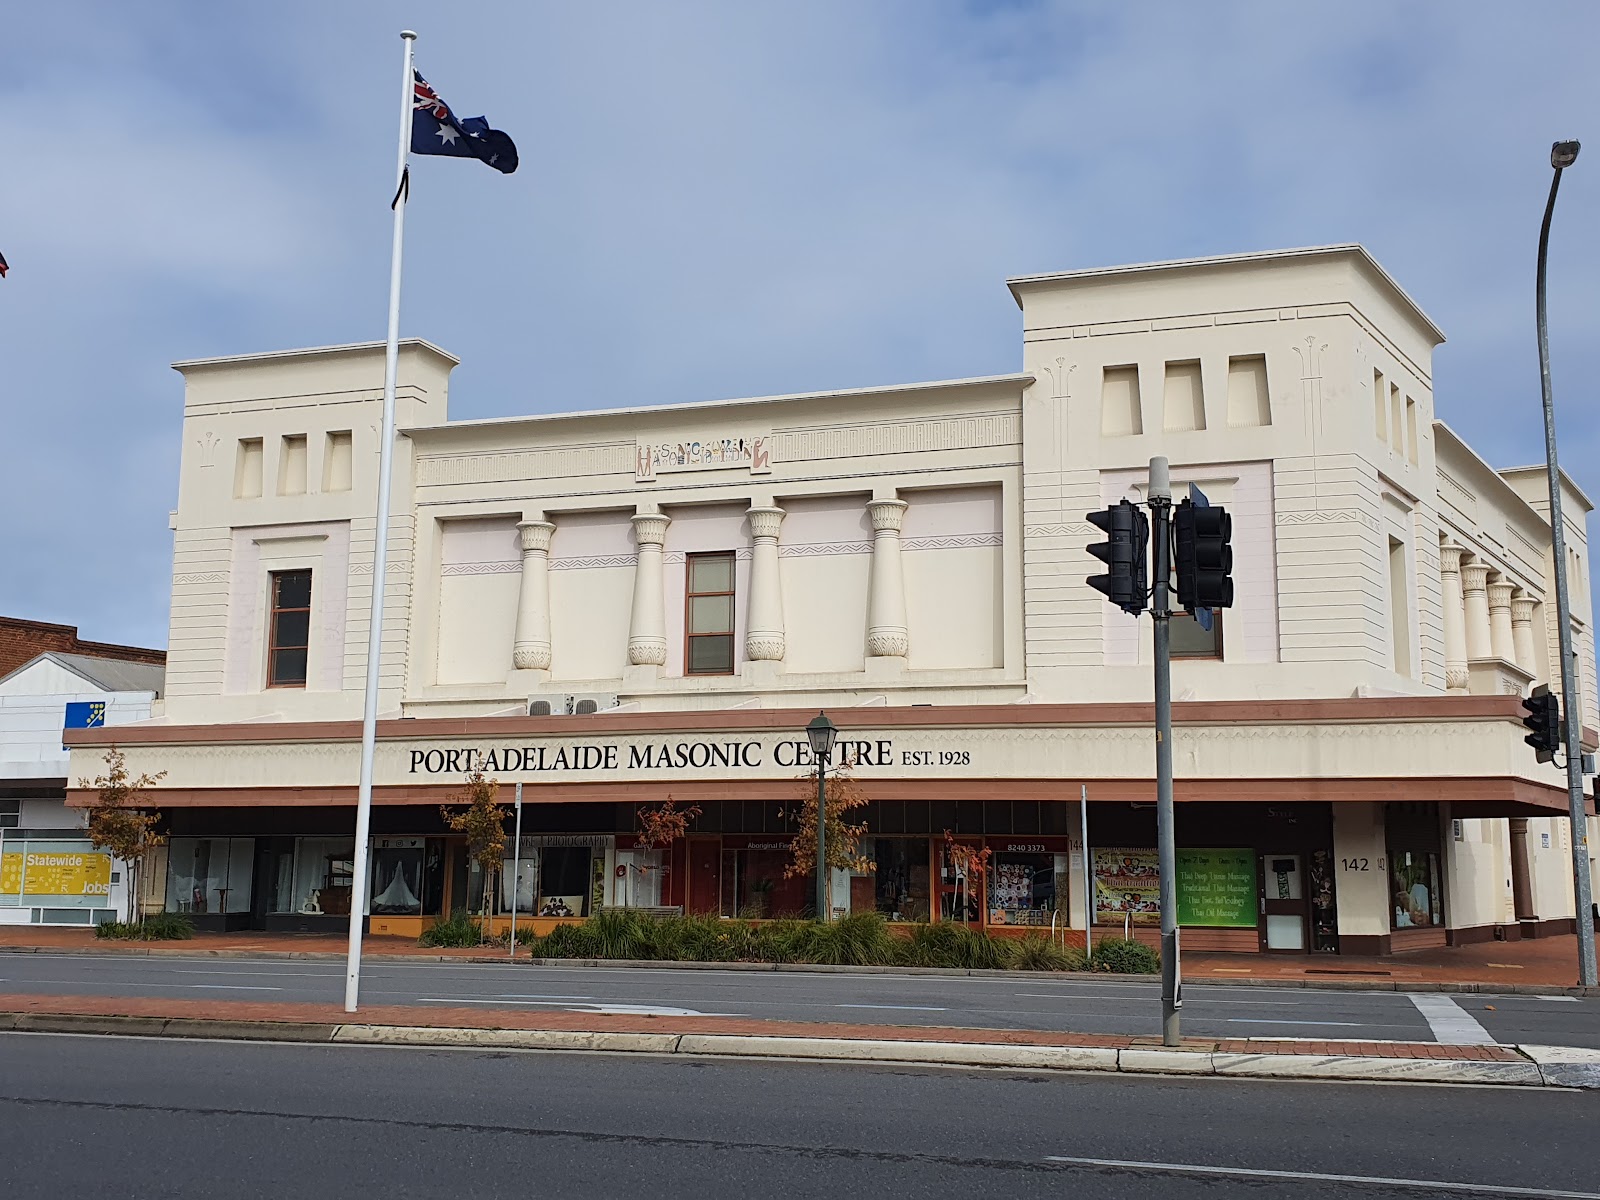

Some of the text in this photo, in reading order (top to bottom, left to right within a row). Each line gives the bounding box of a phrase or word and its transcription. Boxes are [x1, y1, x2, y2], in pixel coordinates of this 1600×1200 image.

[409, 740, 971, 774] PORT ADELAIDE MASONIC CENTRE EST. 1928
[508, 836, 610, 847] HWKE PHOTOGRAPHY
[747, 842, 778, 850] Aboriginal
[1007, 844, 1046, 852] 8240 3373
[27, 854, 83, 867] Statewide
[1341, 858, 1370, 872] 142
[1377, 857, 1385, 871] 142
[1227, 872, 1250, 882] Massage
[82, 881, 109, 893] Jobs
[1182, 884, 1211, 892] Traditional
[1227, 884, 1250, 895] Massage
[1206, 908, 1215, 916] Oil
[1216, 908, 1239, 920] Massage
